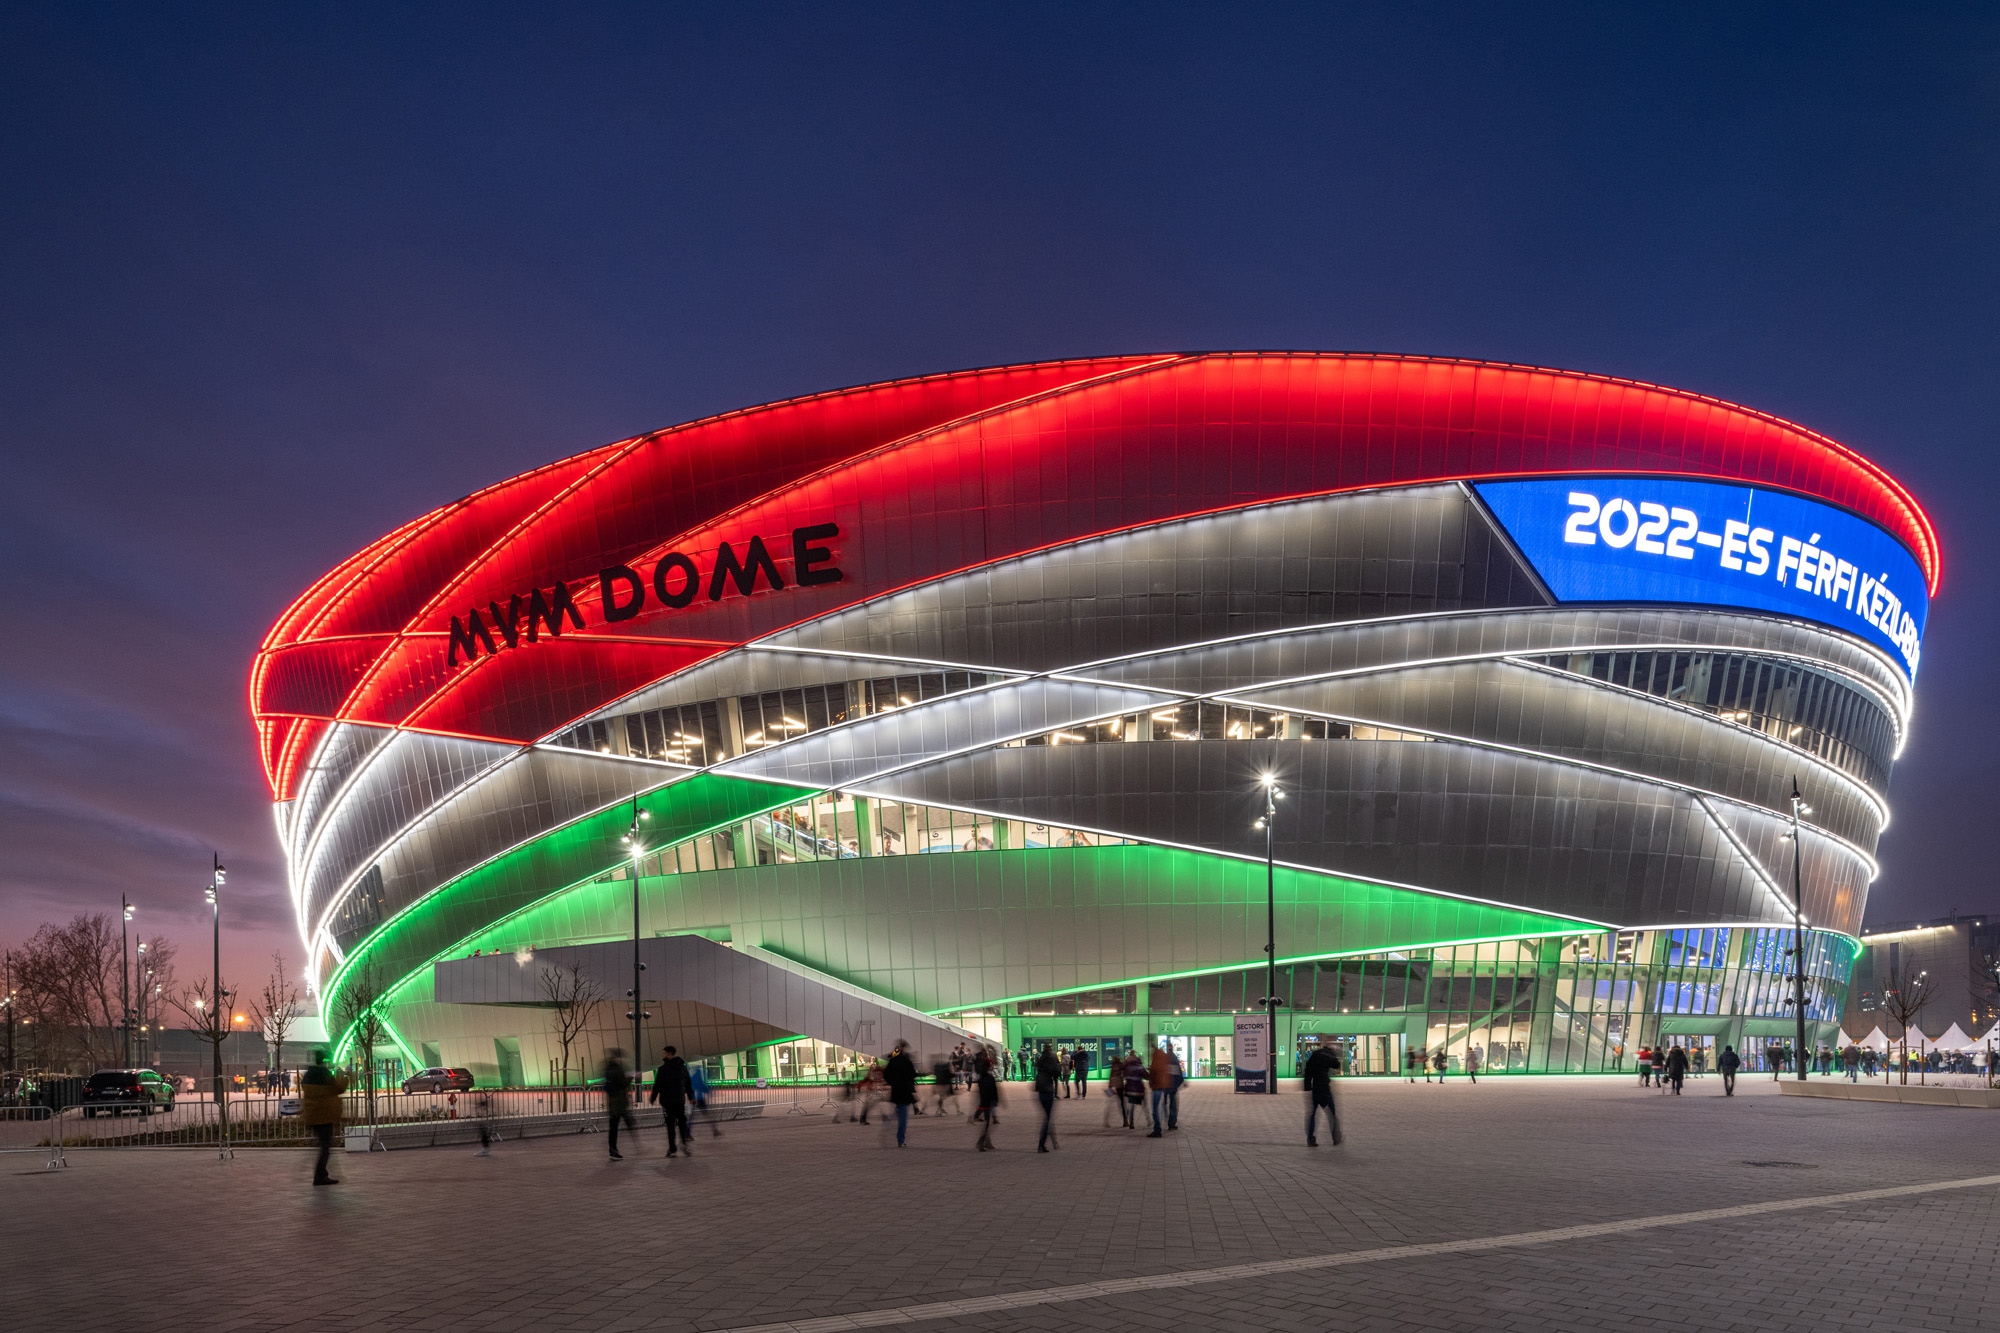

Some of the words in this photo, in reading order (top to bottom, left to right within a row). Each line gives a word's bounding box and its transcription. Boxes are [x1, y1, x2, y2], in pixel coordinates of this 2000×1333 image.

[1564, 491, 1774, 576] 2022-ES
[1776, 532, 1859, 611] FÉRFI
[448, 580, 586, 667] MVM
[598, 522, 844, 622] DOME
[841, 1020, 876, 1046] VI
[1161, 1020, 1182, 1032] IV
[1057, 1042, 1075, 1052] EURO
[1080, 1042, 1098, 1052] 2022
